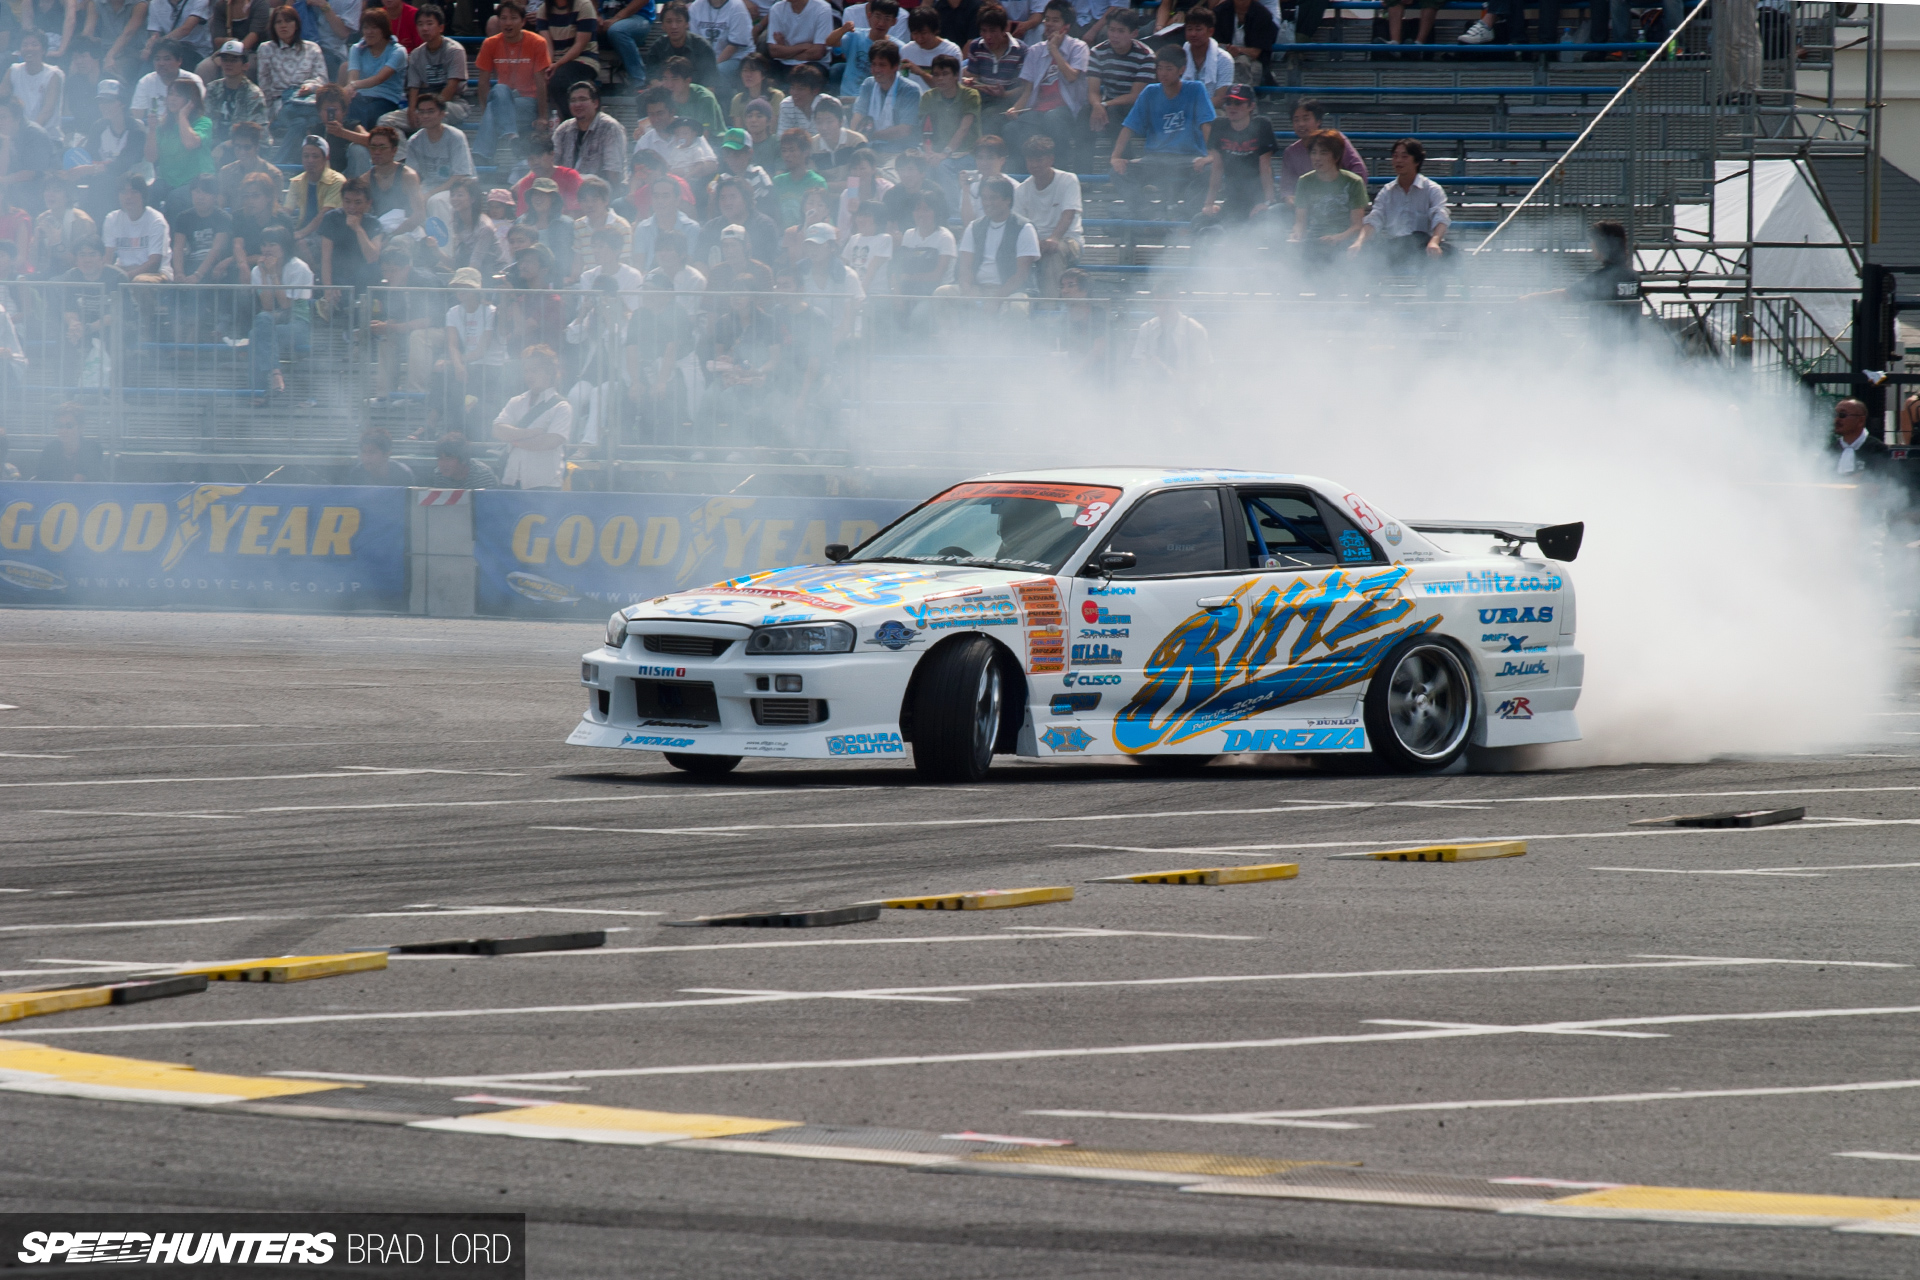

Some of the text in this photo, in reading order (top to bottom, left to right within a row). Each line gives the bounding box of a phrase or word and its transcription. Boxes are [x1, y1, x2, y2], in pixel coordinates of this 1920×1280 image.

[1075, 501, 1111, 526] 3
[1347, 494, 1382, 531] 3
[1423, 570, 1563, 595] www.blitz.co.jp
[904, 602, 1017, 630] YOKOMO
[1083, 606, 1109, 616] SPEED
[1477, 606, 1554, 624] URAS
[1481, 633, 1509, 642] DRIFT
[638, 665, 686, 678] nismo
[1077, 674, 1122, 686] CUSCO
[1229, 690, 1275, 712] 2004
[1316, 717, 1360, 727] DUNLOP
[631, 735, 696, 748] DUNLOP
[844, 732, 902, 745] OGURA
[1222, 727, 1365, 752] DIREZZA
[846, 743, 904, 756] CLUTCH
